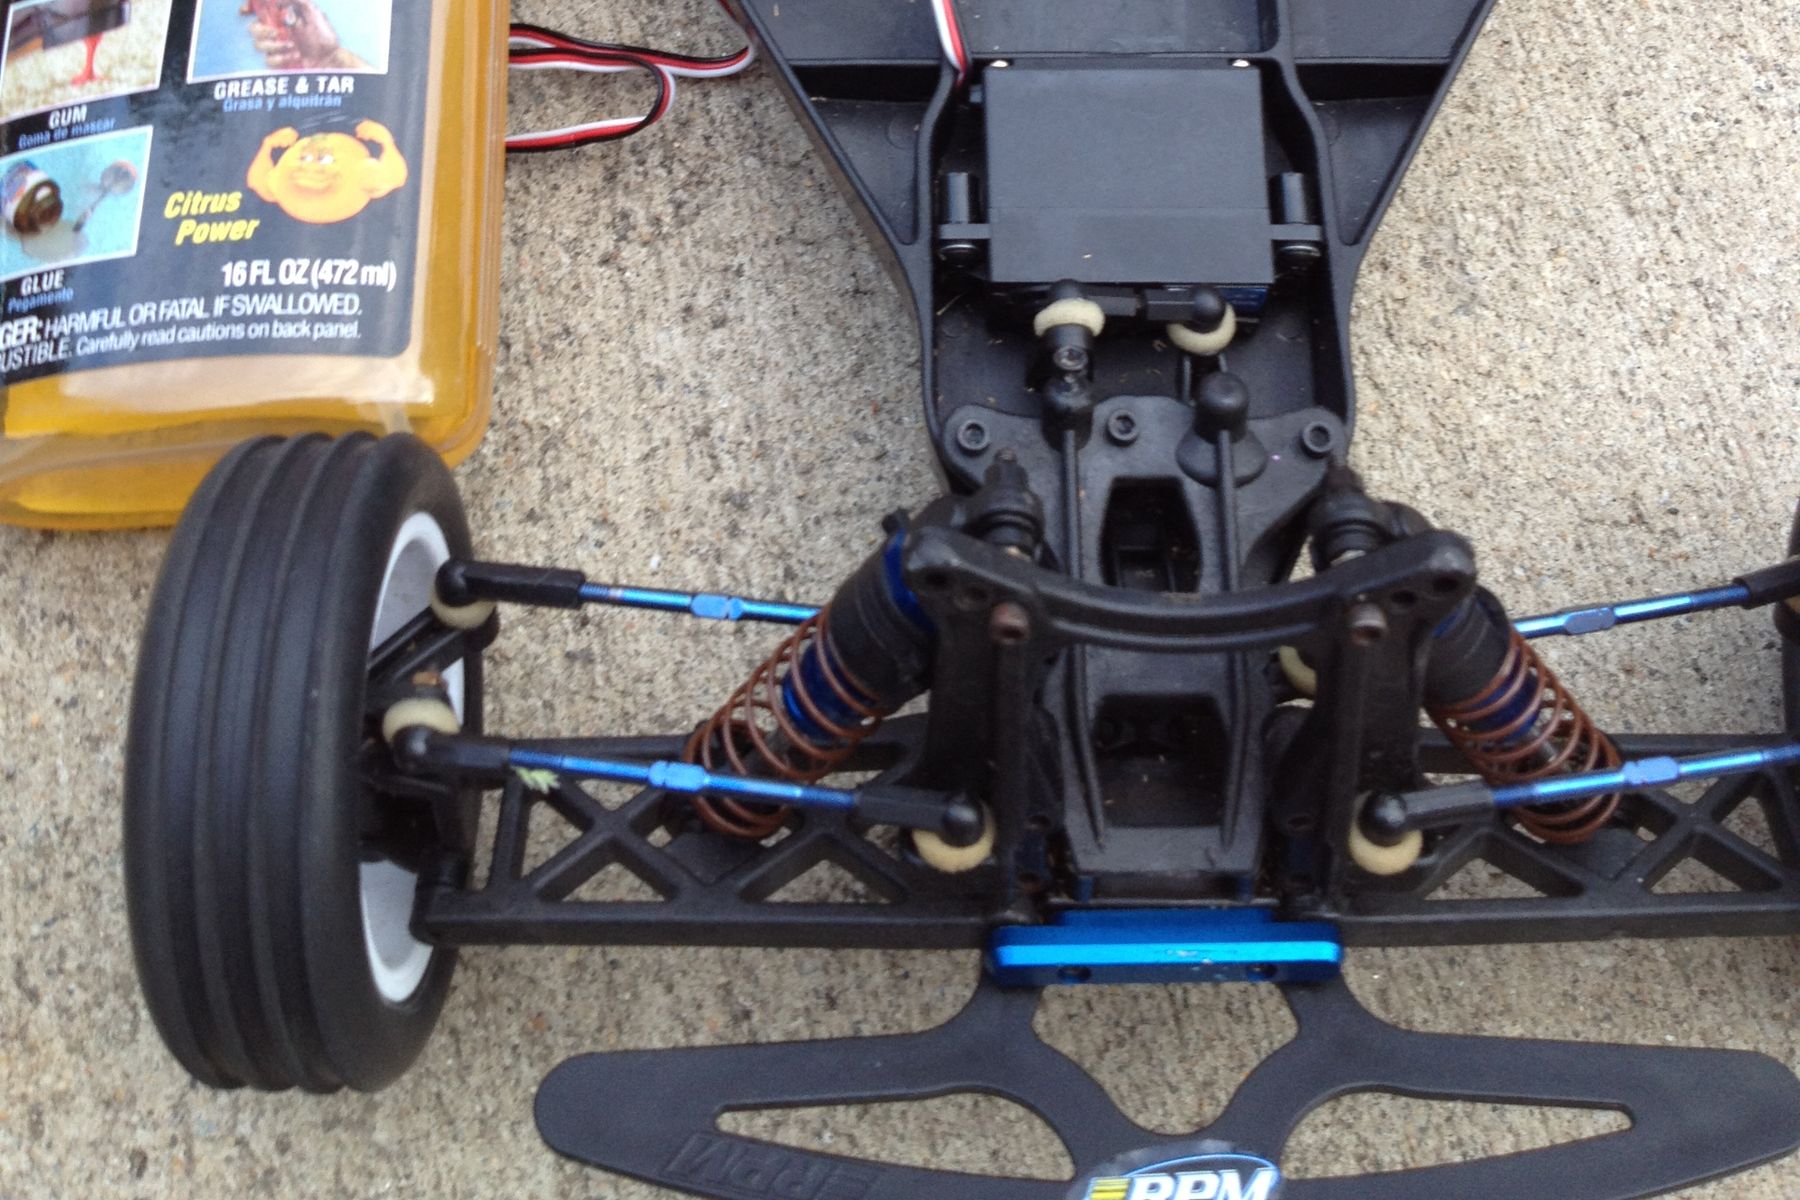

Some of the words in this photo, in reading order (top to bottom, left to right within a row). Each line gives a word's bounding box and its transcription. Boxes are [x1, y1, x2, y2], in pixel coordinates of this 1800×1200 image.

[214, 76, 289, 100] GREASE
[295, 76, 309, 94] &
[317, 75, 354, 94] TAR
[49, 104, 87, 129] GUM
[223, 97, 262, 112] Grasa
[164, 191, 242, 219] Citrus
[175, 219, 260, 245] Power
[21, 269, 64, 296] GLUE
[221, 261, 247, 287] 16
[249, 260, 275, 286] FL
[279, 258, 310, 285] OZ
[310, 258, 359, 289] (472
[360, 261, 397, 292] ml)
[44, 306, 126, 338] HARMFUL
[129, 301, 157, 326] OR
[158, 297, 209, 323] FATAL
[213, 296, 232, 317] IF
[232, 292, 362, 316] SWALLOWED.
[76, 330, 140, 356] Carefully
[142, 325, 175, 346] read
[177, 322, 245, 346] cautions
[247, 323, 269, 340] on
[272, 320, 311, 339] back
[313, 320, 361, 341] panel.
[1129, 1166, 1277, 1200] RPM
